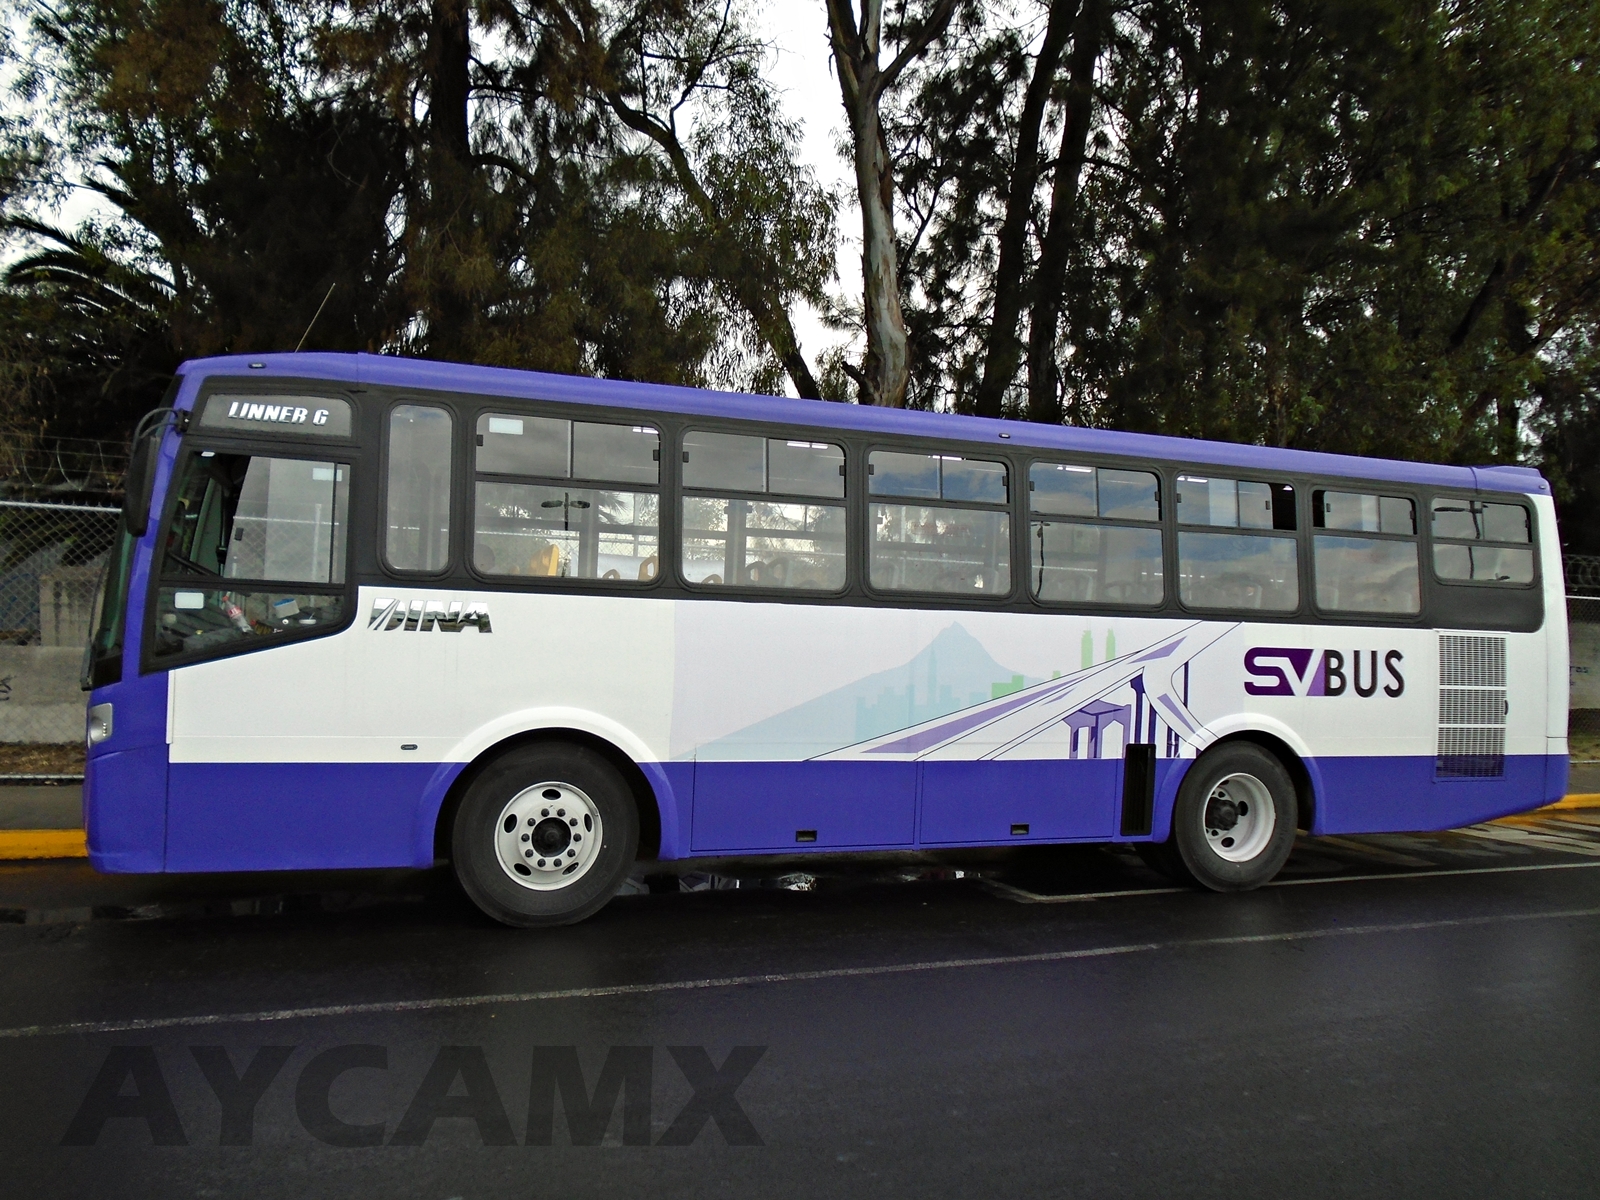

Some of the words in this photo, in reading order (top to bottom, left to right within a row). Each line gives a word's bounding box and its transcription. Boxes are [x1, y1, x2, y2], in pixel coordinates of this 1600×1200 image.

[228, 401, 308, 425] LINNER
[312, 409, 330, 426] G
[367, 598, 493, 633] DINA
